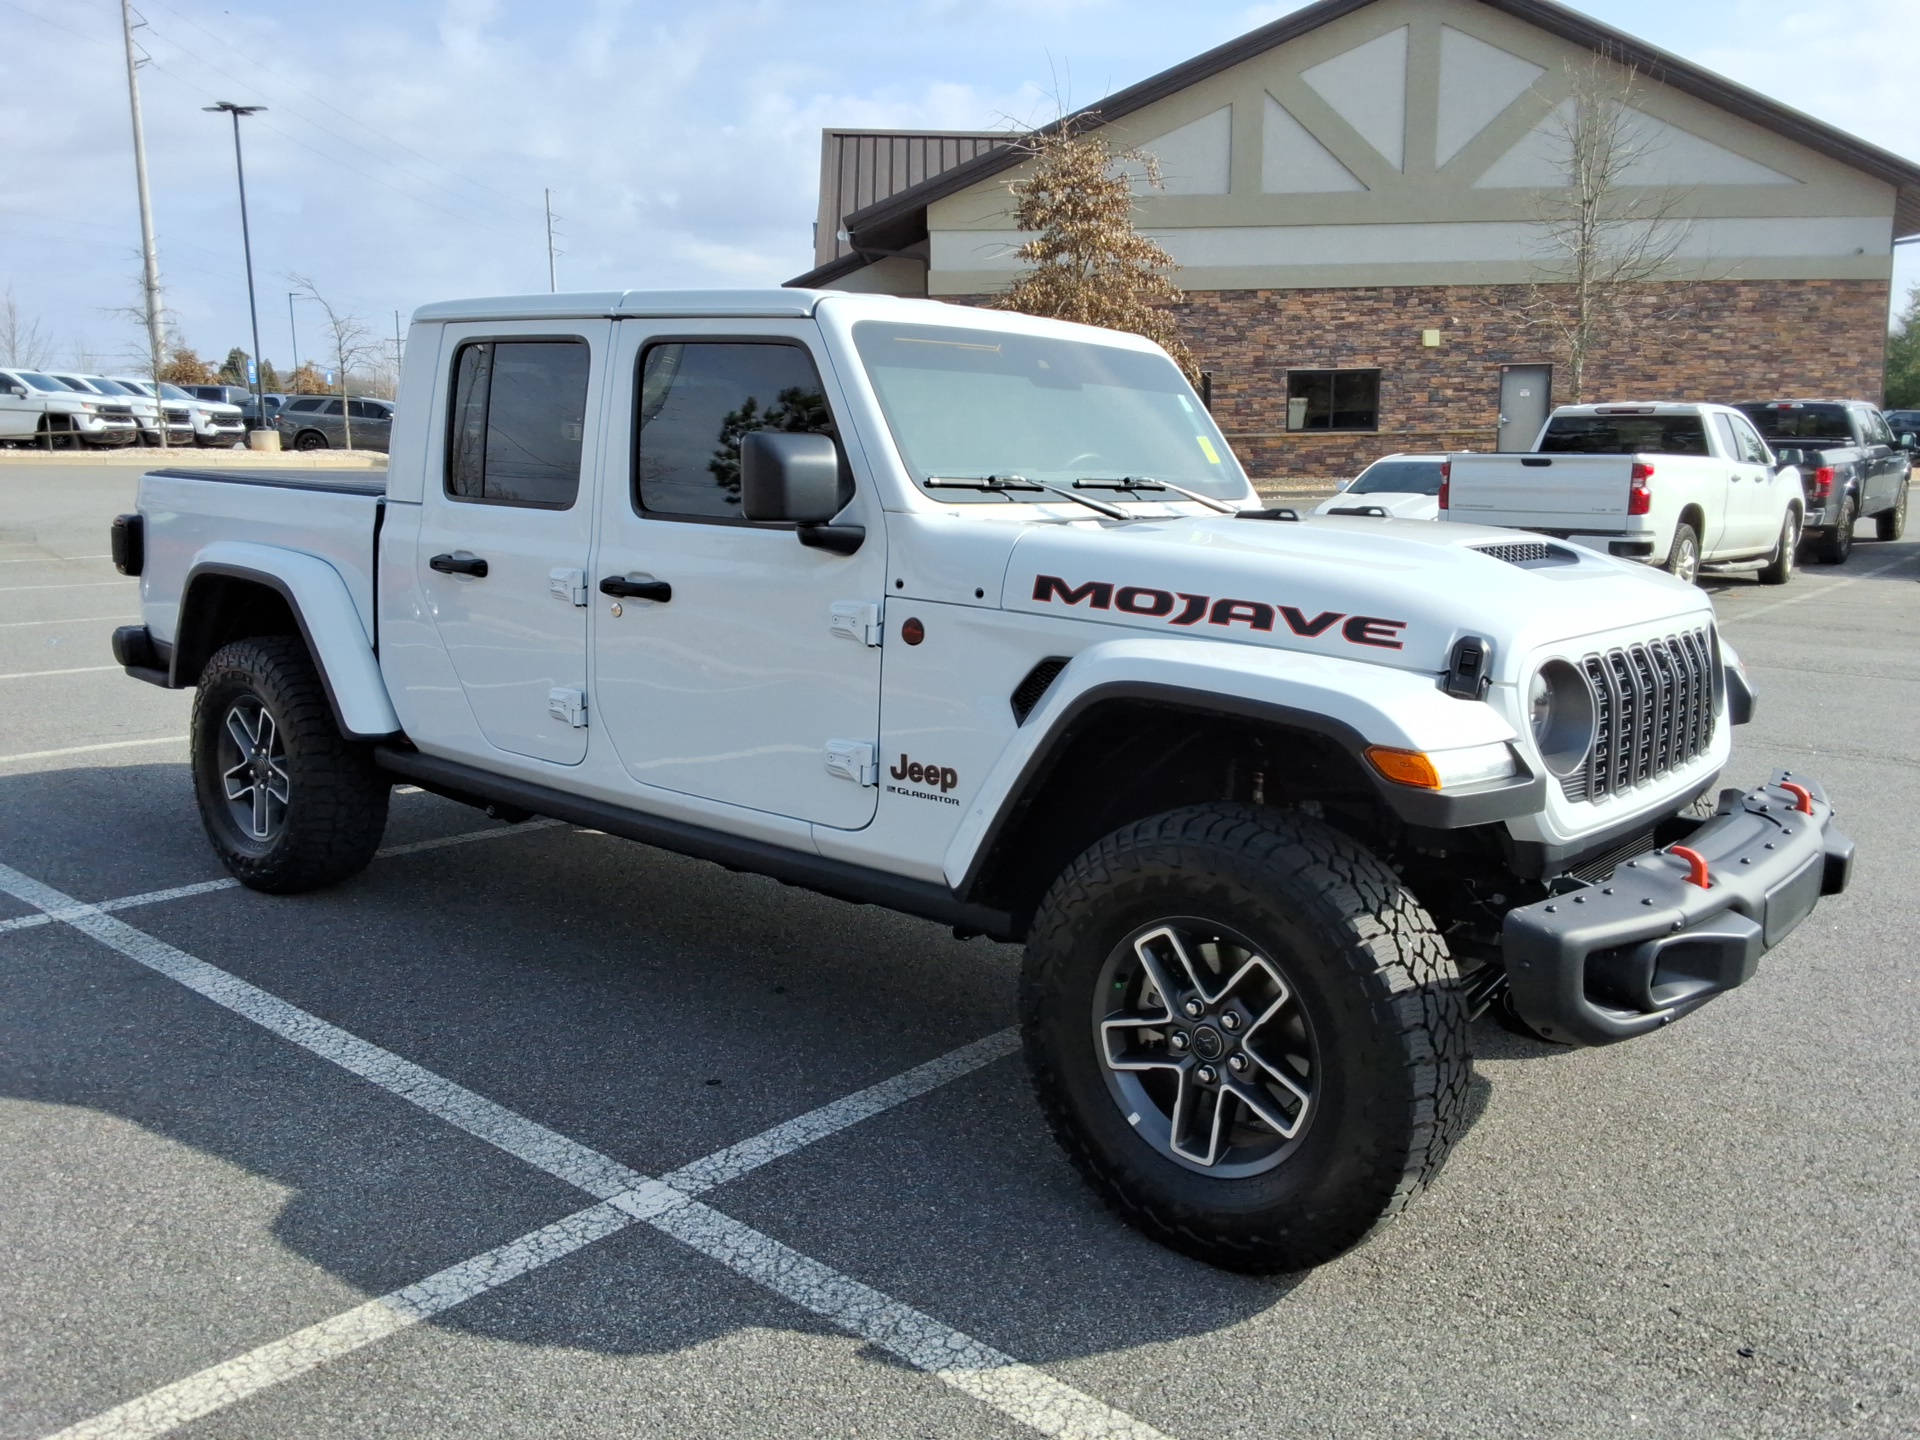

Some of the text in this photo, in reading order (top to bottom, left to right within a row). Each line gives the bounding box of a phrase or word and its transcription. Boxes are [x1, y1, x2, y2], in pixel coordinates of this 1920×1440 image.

[1032, 574, 1407, 650] MOJAVE
[890, 753, 958, 793] Jeep
[897, 787, 960, 806] GLADIATOR
